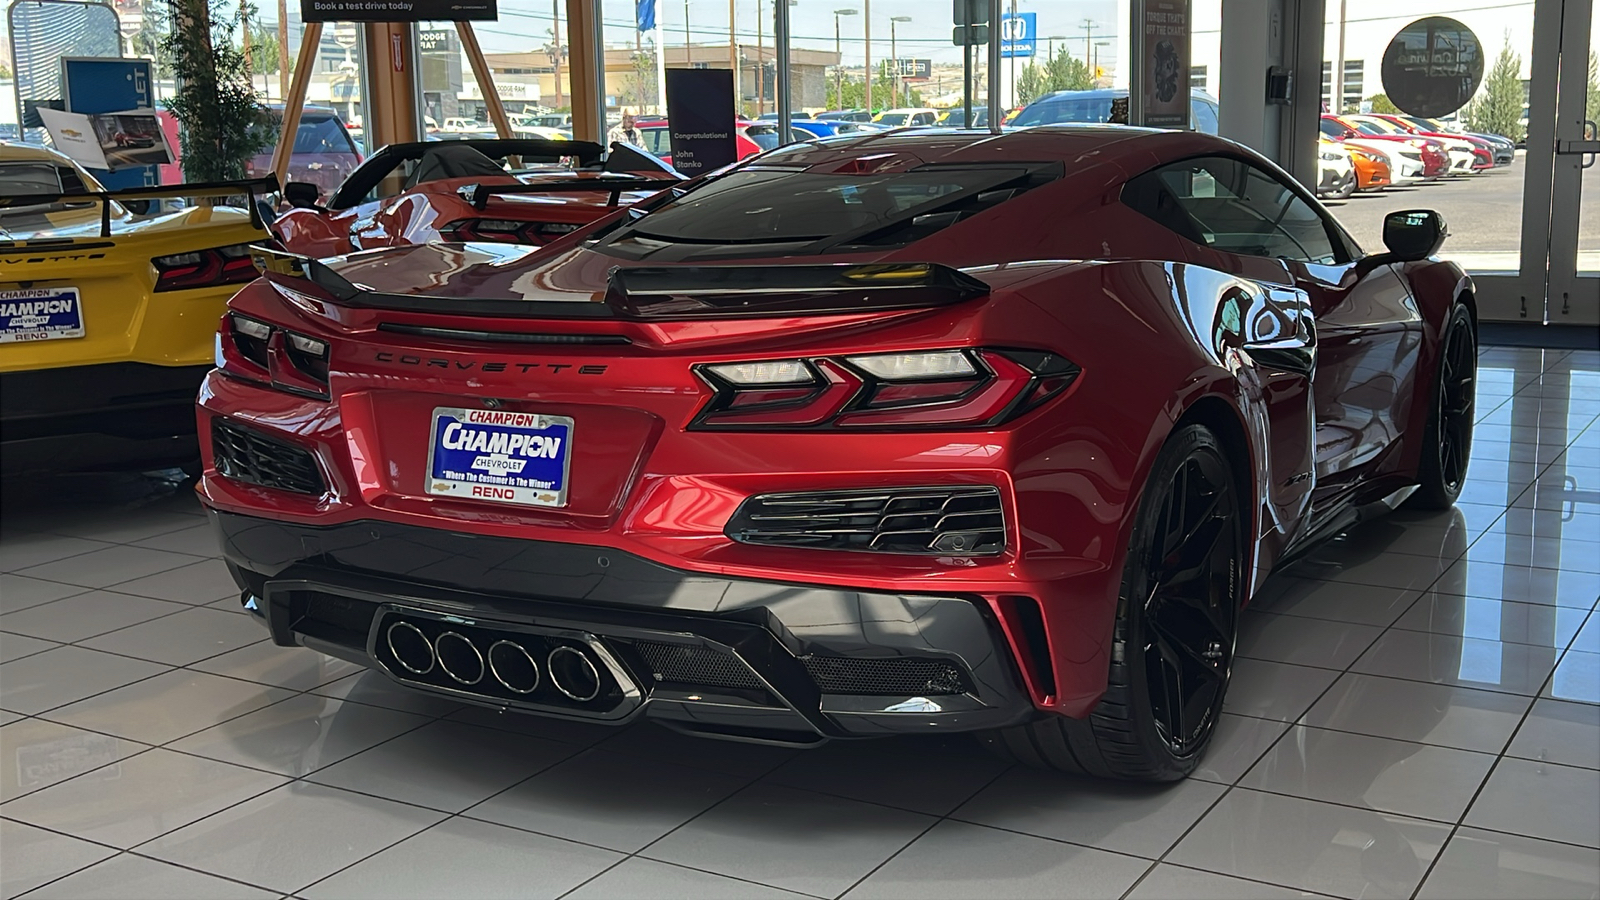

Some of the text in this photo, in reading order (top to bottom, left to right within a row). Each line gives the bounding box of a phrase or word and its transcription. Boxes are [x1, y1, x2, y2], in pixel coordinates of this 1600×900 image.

[314, 2, 337, 11] Book
[345, 2, 364, 10] test
[365, 1, 387, 10] drive
[388, 2, 413, 12] today
[1146, 11, 1185, 24] TORQUE THAT'S
[1146, 24, 1156, 35] OFF
[1156, 25, 1167, 35] THE
[420, 32, 446, 41] DODGE
[420, 41, 437, 49] FIAT
[674, 132, 728, 140] Congratulations!
[675, 150, 694, 158] John
[676, 160, 702, 168] Stanko
[0, 289, 50, 299] CHAMPION
[0, 299, 73, 317] HAMPION
[11, 317, 47, 325] CHEVROLET
[15, 332, 49, 341] RENO
[374, 351, 609, 375] CORVETTE
[469, 410, 535, 427] CHAMPION
[442, 422, 561, 459] CHAMPION
[475, 457, 522, 471] CHEVROLET
[466, 472, 477, 482] The
[478, 473, 508, 485] Customer
[508, 476, 515, 486] Is
[516, 476, 528, 487] The
[472, 485, 515, 500] RENO
